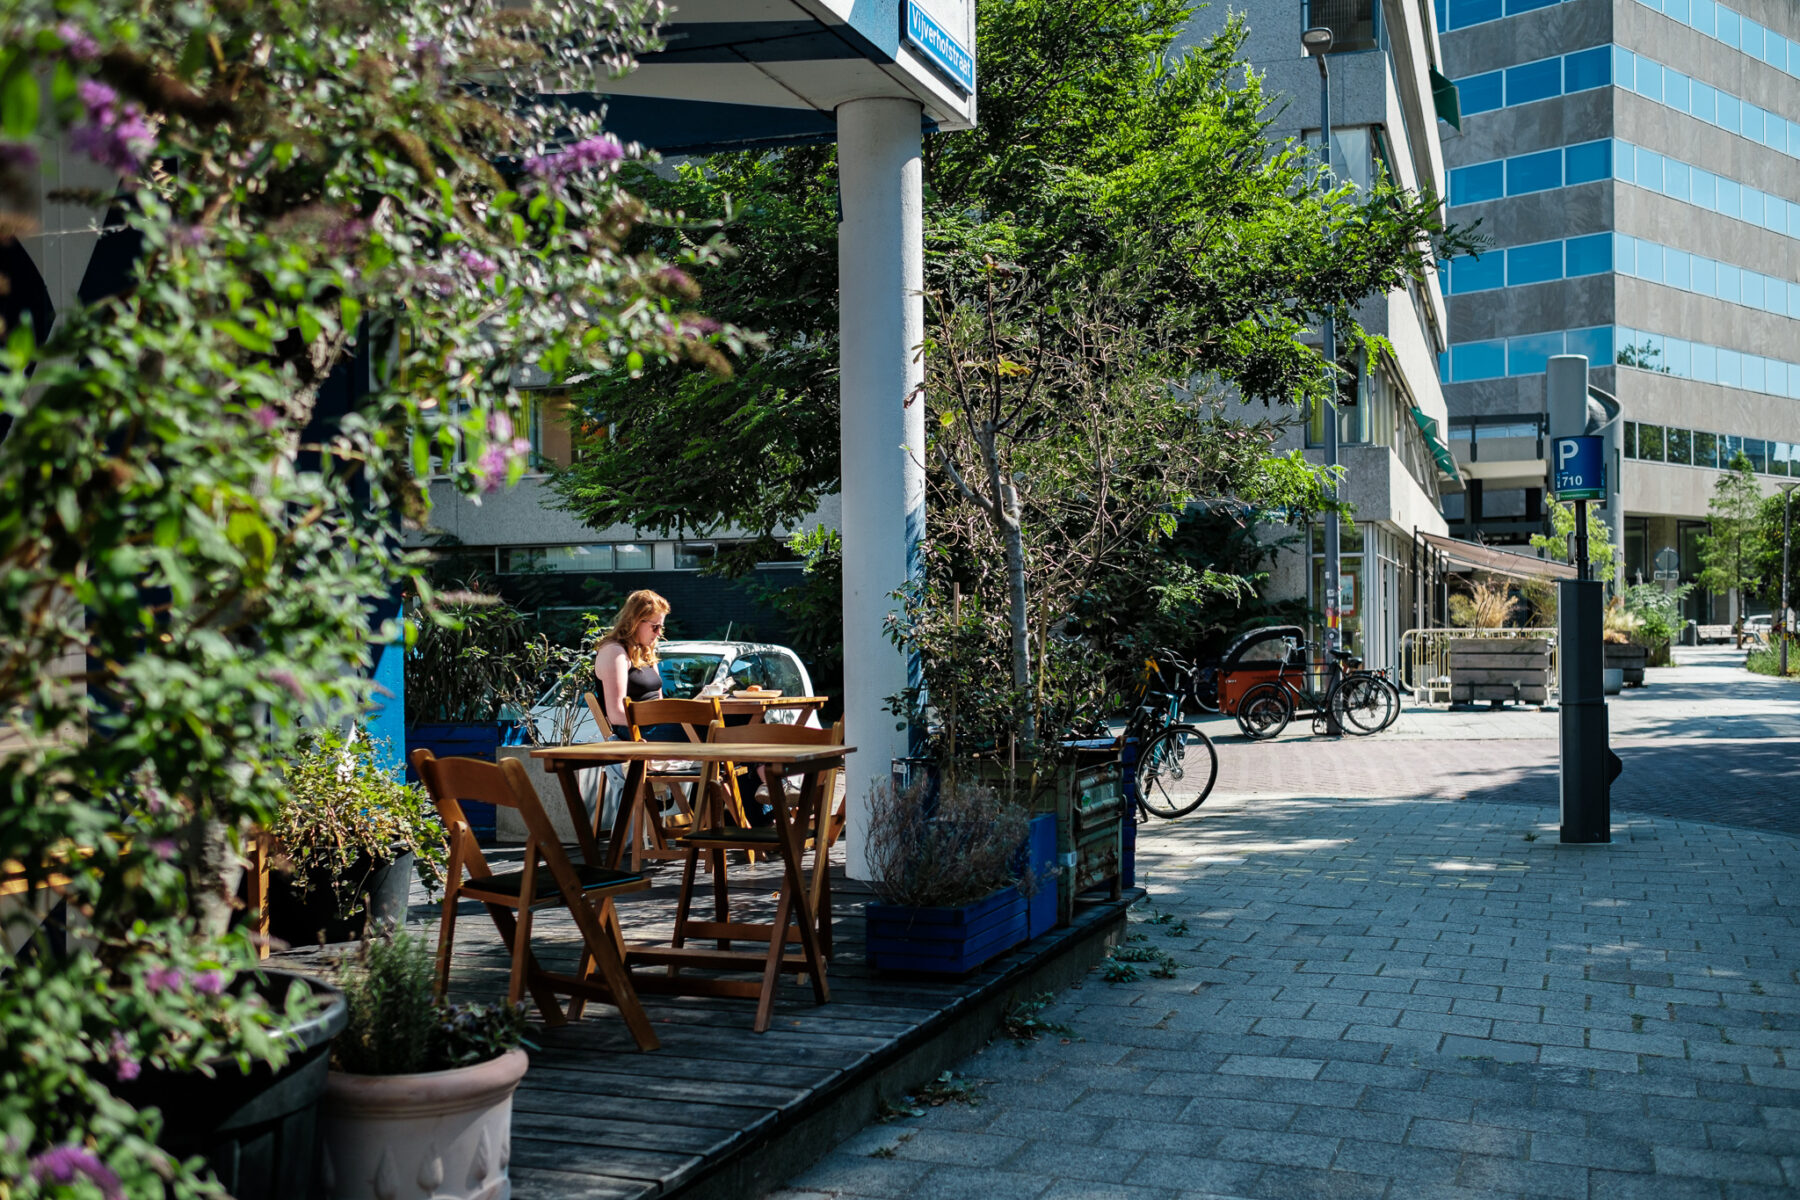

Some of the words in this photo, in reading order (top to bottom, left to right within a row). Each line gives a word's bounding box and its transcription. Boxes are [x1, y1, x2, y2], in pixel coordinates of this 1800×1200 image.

[912, 6, 971, 78] Vijverhofstraat
[1559, 440, 1579, 470] P
[1562, 475, 1583, 487] 710
